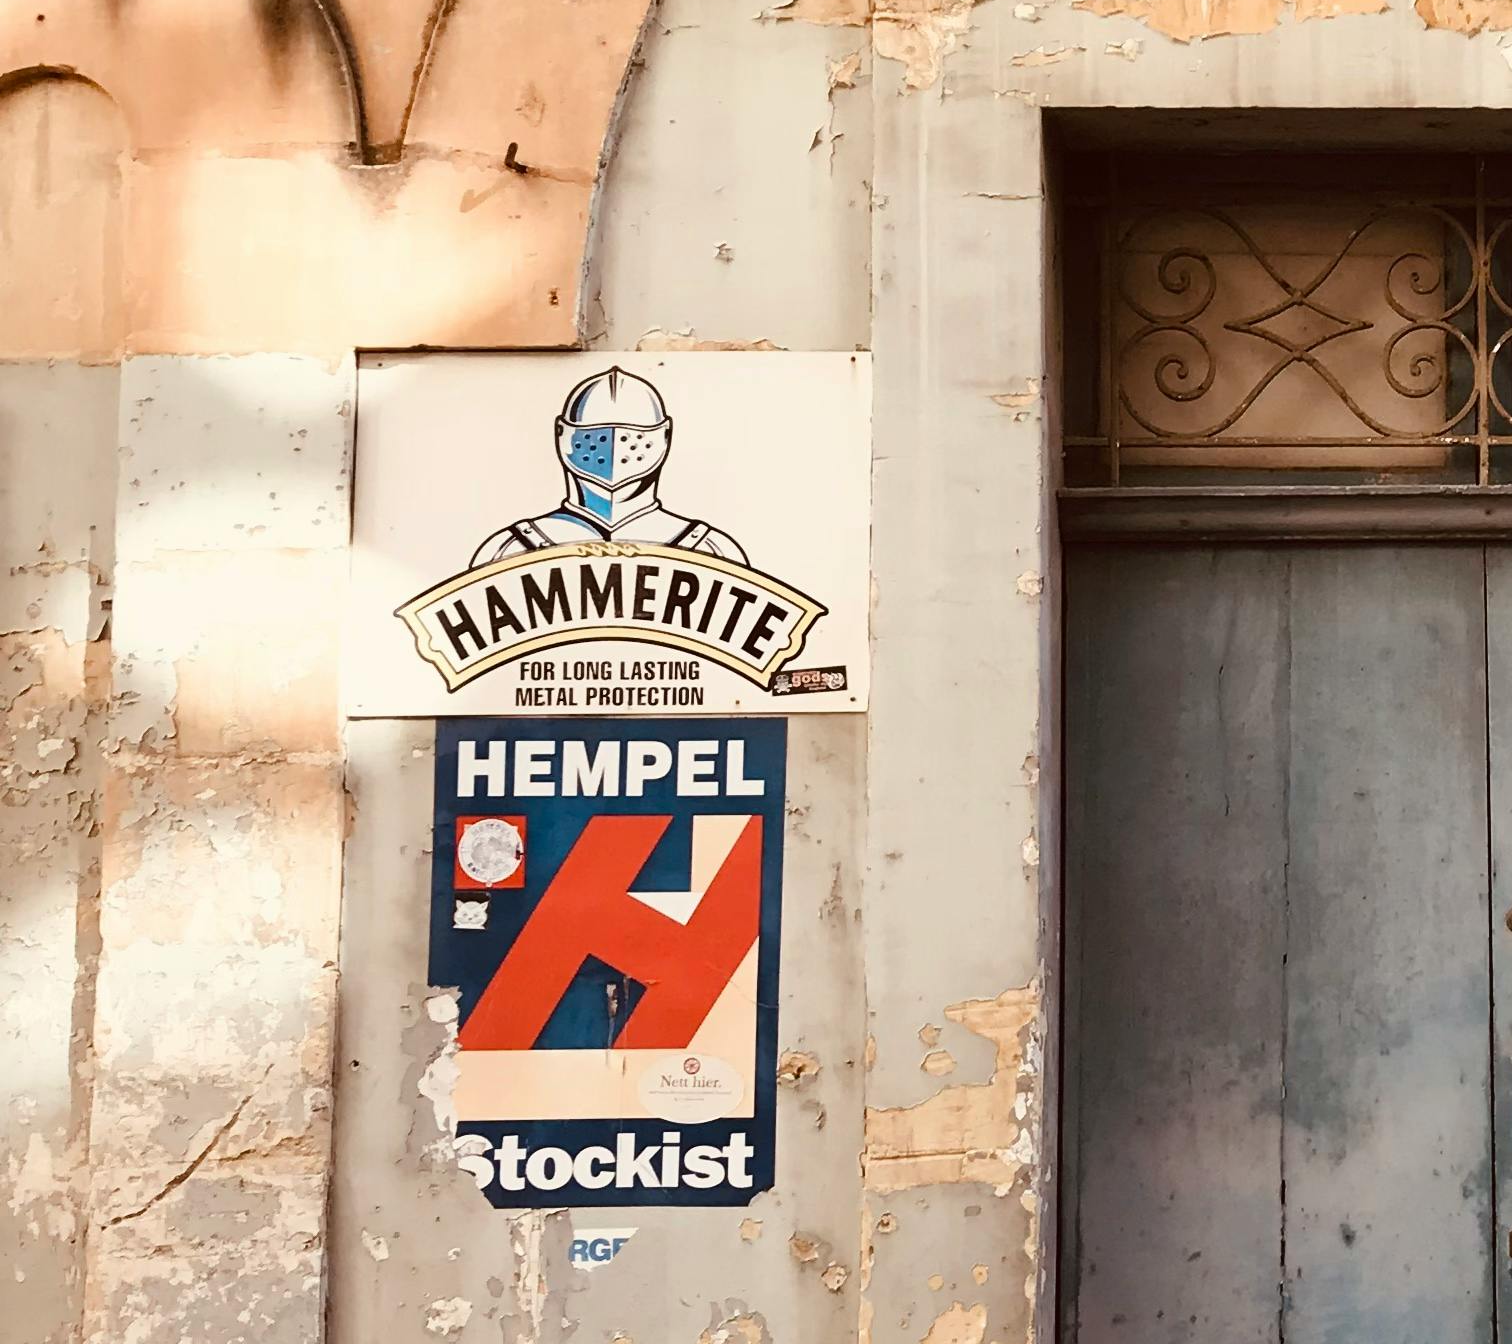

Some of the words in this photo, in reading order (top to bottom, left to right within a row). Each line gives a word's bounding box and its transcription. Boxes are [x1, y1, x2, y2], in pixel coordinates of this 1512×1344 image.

[435, 563, 790, 661] HAMMERITE
[520, 661, 555, 681] FOR
[563, 661, 612, 681] LONG
[620, 661, 700, 681] LASTING
[515, 687, 578, 707] METAL
[586, 687, 704, 706] PROTECTION
[456, 739, 765, 798] HEMPEL
[660, 1074, 689, 1088] Nett
[454, 1131, 754, 1191] Stockist
